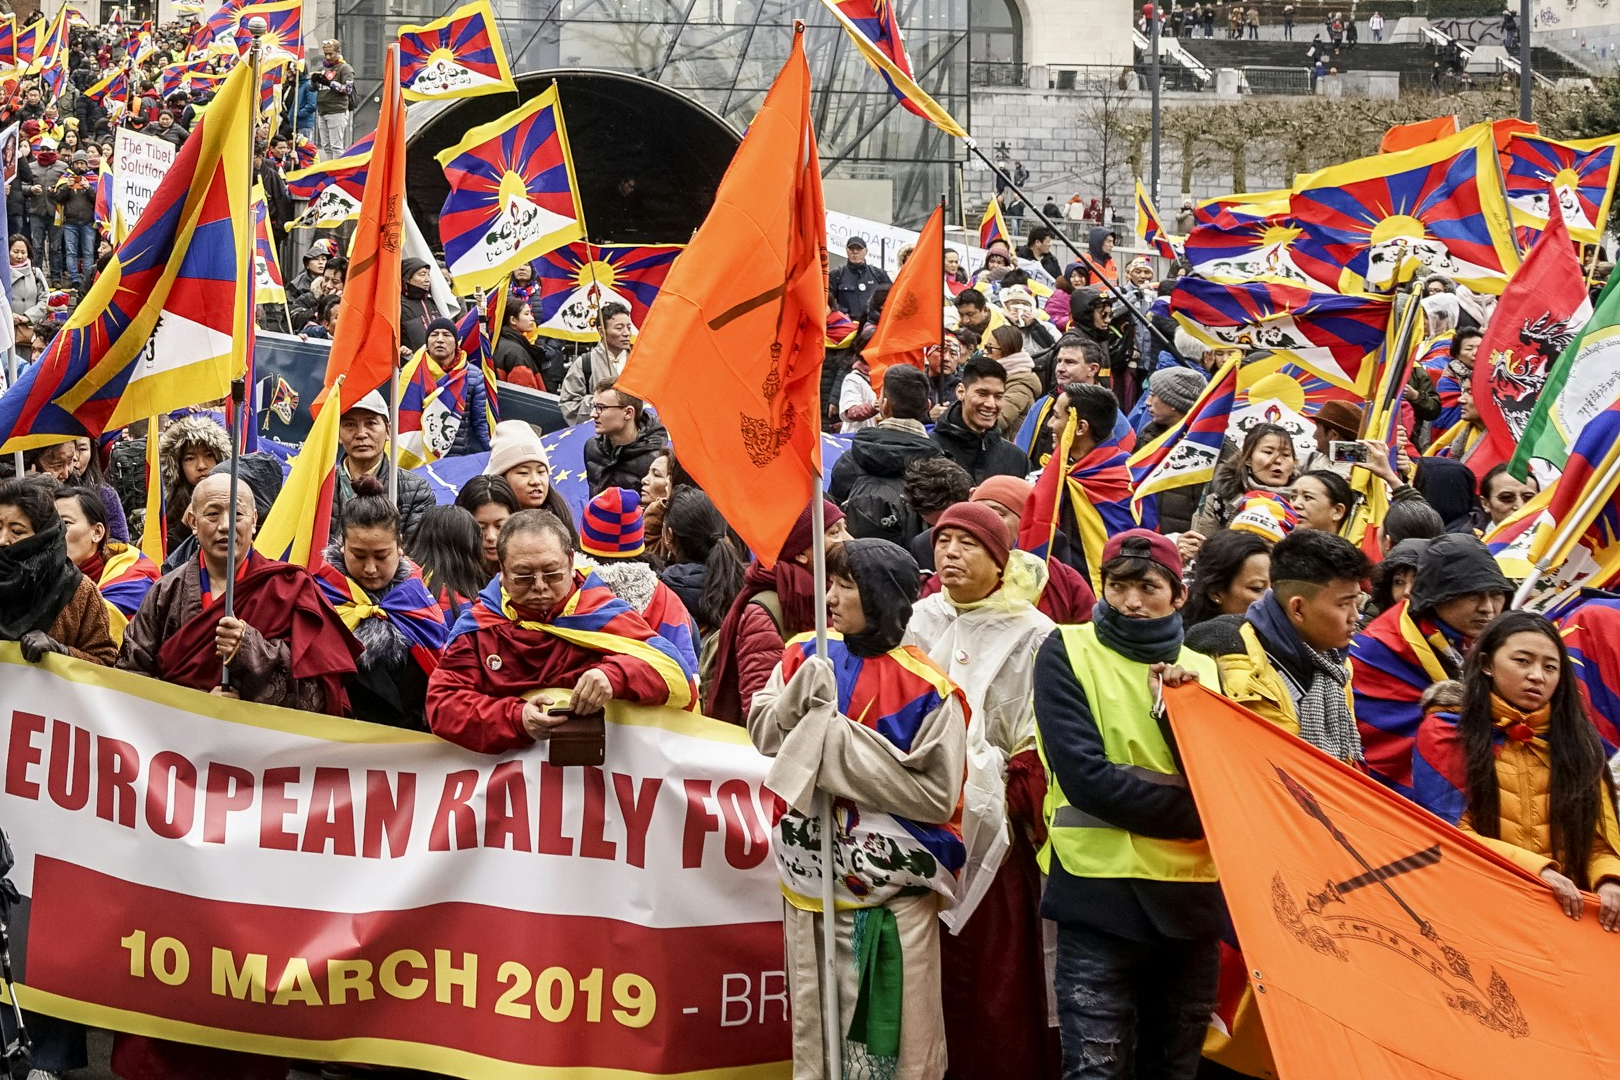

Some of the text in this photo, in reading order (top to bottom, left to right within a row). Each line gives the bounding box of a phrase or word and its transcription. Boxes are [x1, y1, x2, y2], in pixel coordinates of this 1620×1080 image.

[122, 137, 172, 164] The Tibet
[125, 180, 156, 199] Hum
[829, 223, 907, 250] SOLIDARIT
[4, 710, 417, 859] EUROPEAN
[428, 760, 664, 869] RALLY
[120, 929, 190, 986] 10
[211, 947, 479, 1009] MARCH
[494, 961, 658, 1029] 2019
[721, 970, 788, 1027] BR
